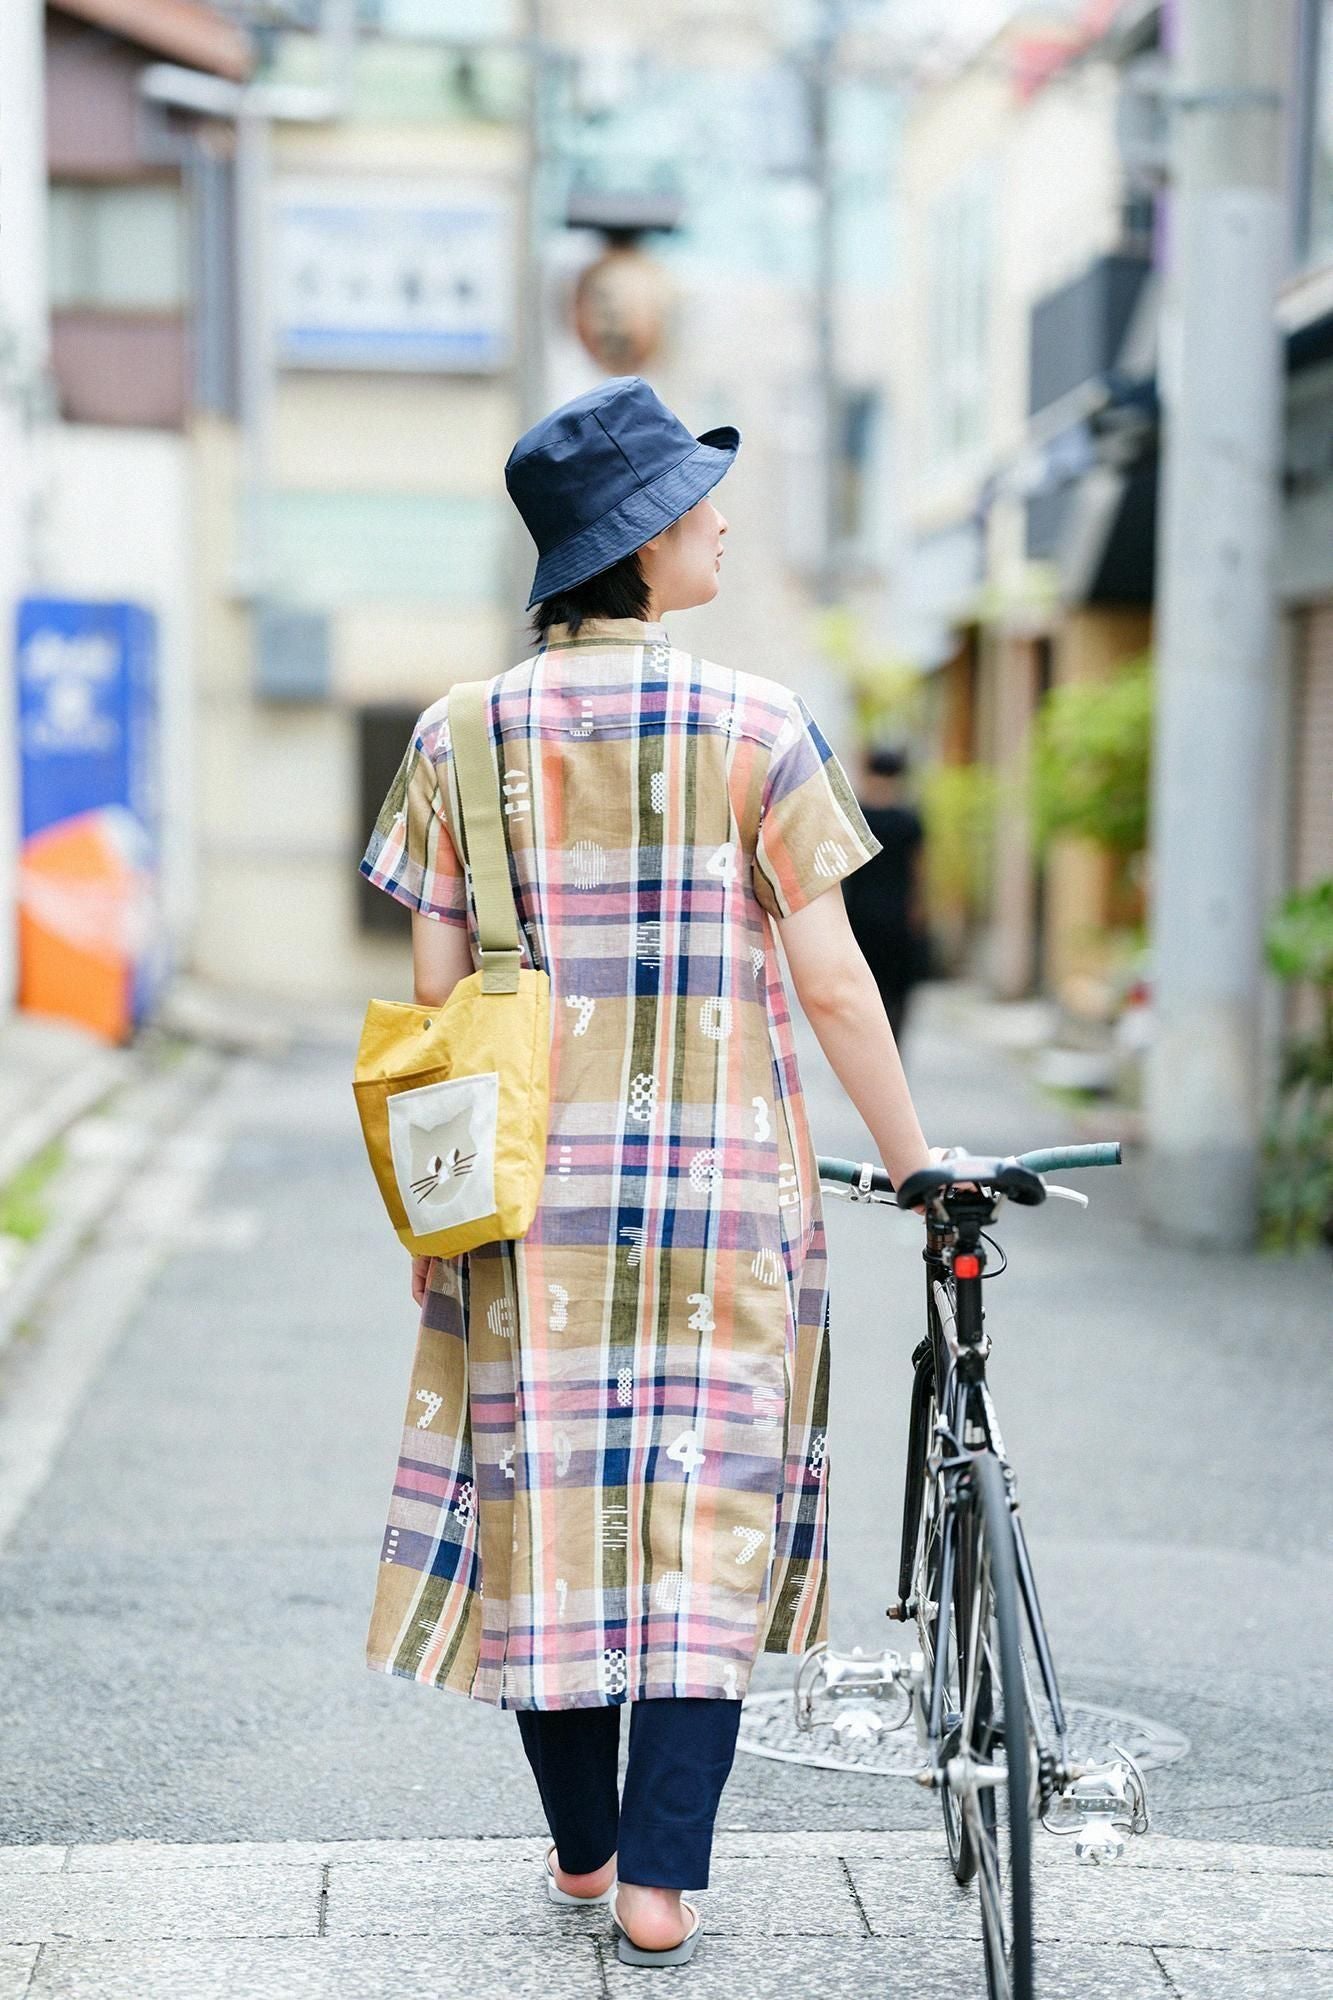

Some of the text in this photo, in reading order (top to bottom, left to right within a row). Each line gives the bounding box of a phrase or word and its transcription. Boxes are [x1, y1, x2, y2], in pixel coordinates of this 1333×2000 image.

[706, 841, 737, 888] 4
[565, 995, 596, 1037] 7
[700, 996, 733, 1040] 0
[752, 1096, 770, 1142] 3
[689, 1148, 724, 1194] 6
[687, 1293, 716, 1331] 2
[415, 1389, 444, 1430] 7
[666, 1430, 706, 1473] 4
[732, 1525, 766, 1566] 7
[656, 1570, 692, 1611] 0
